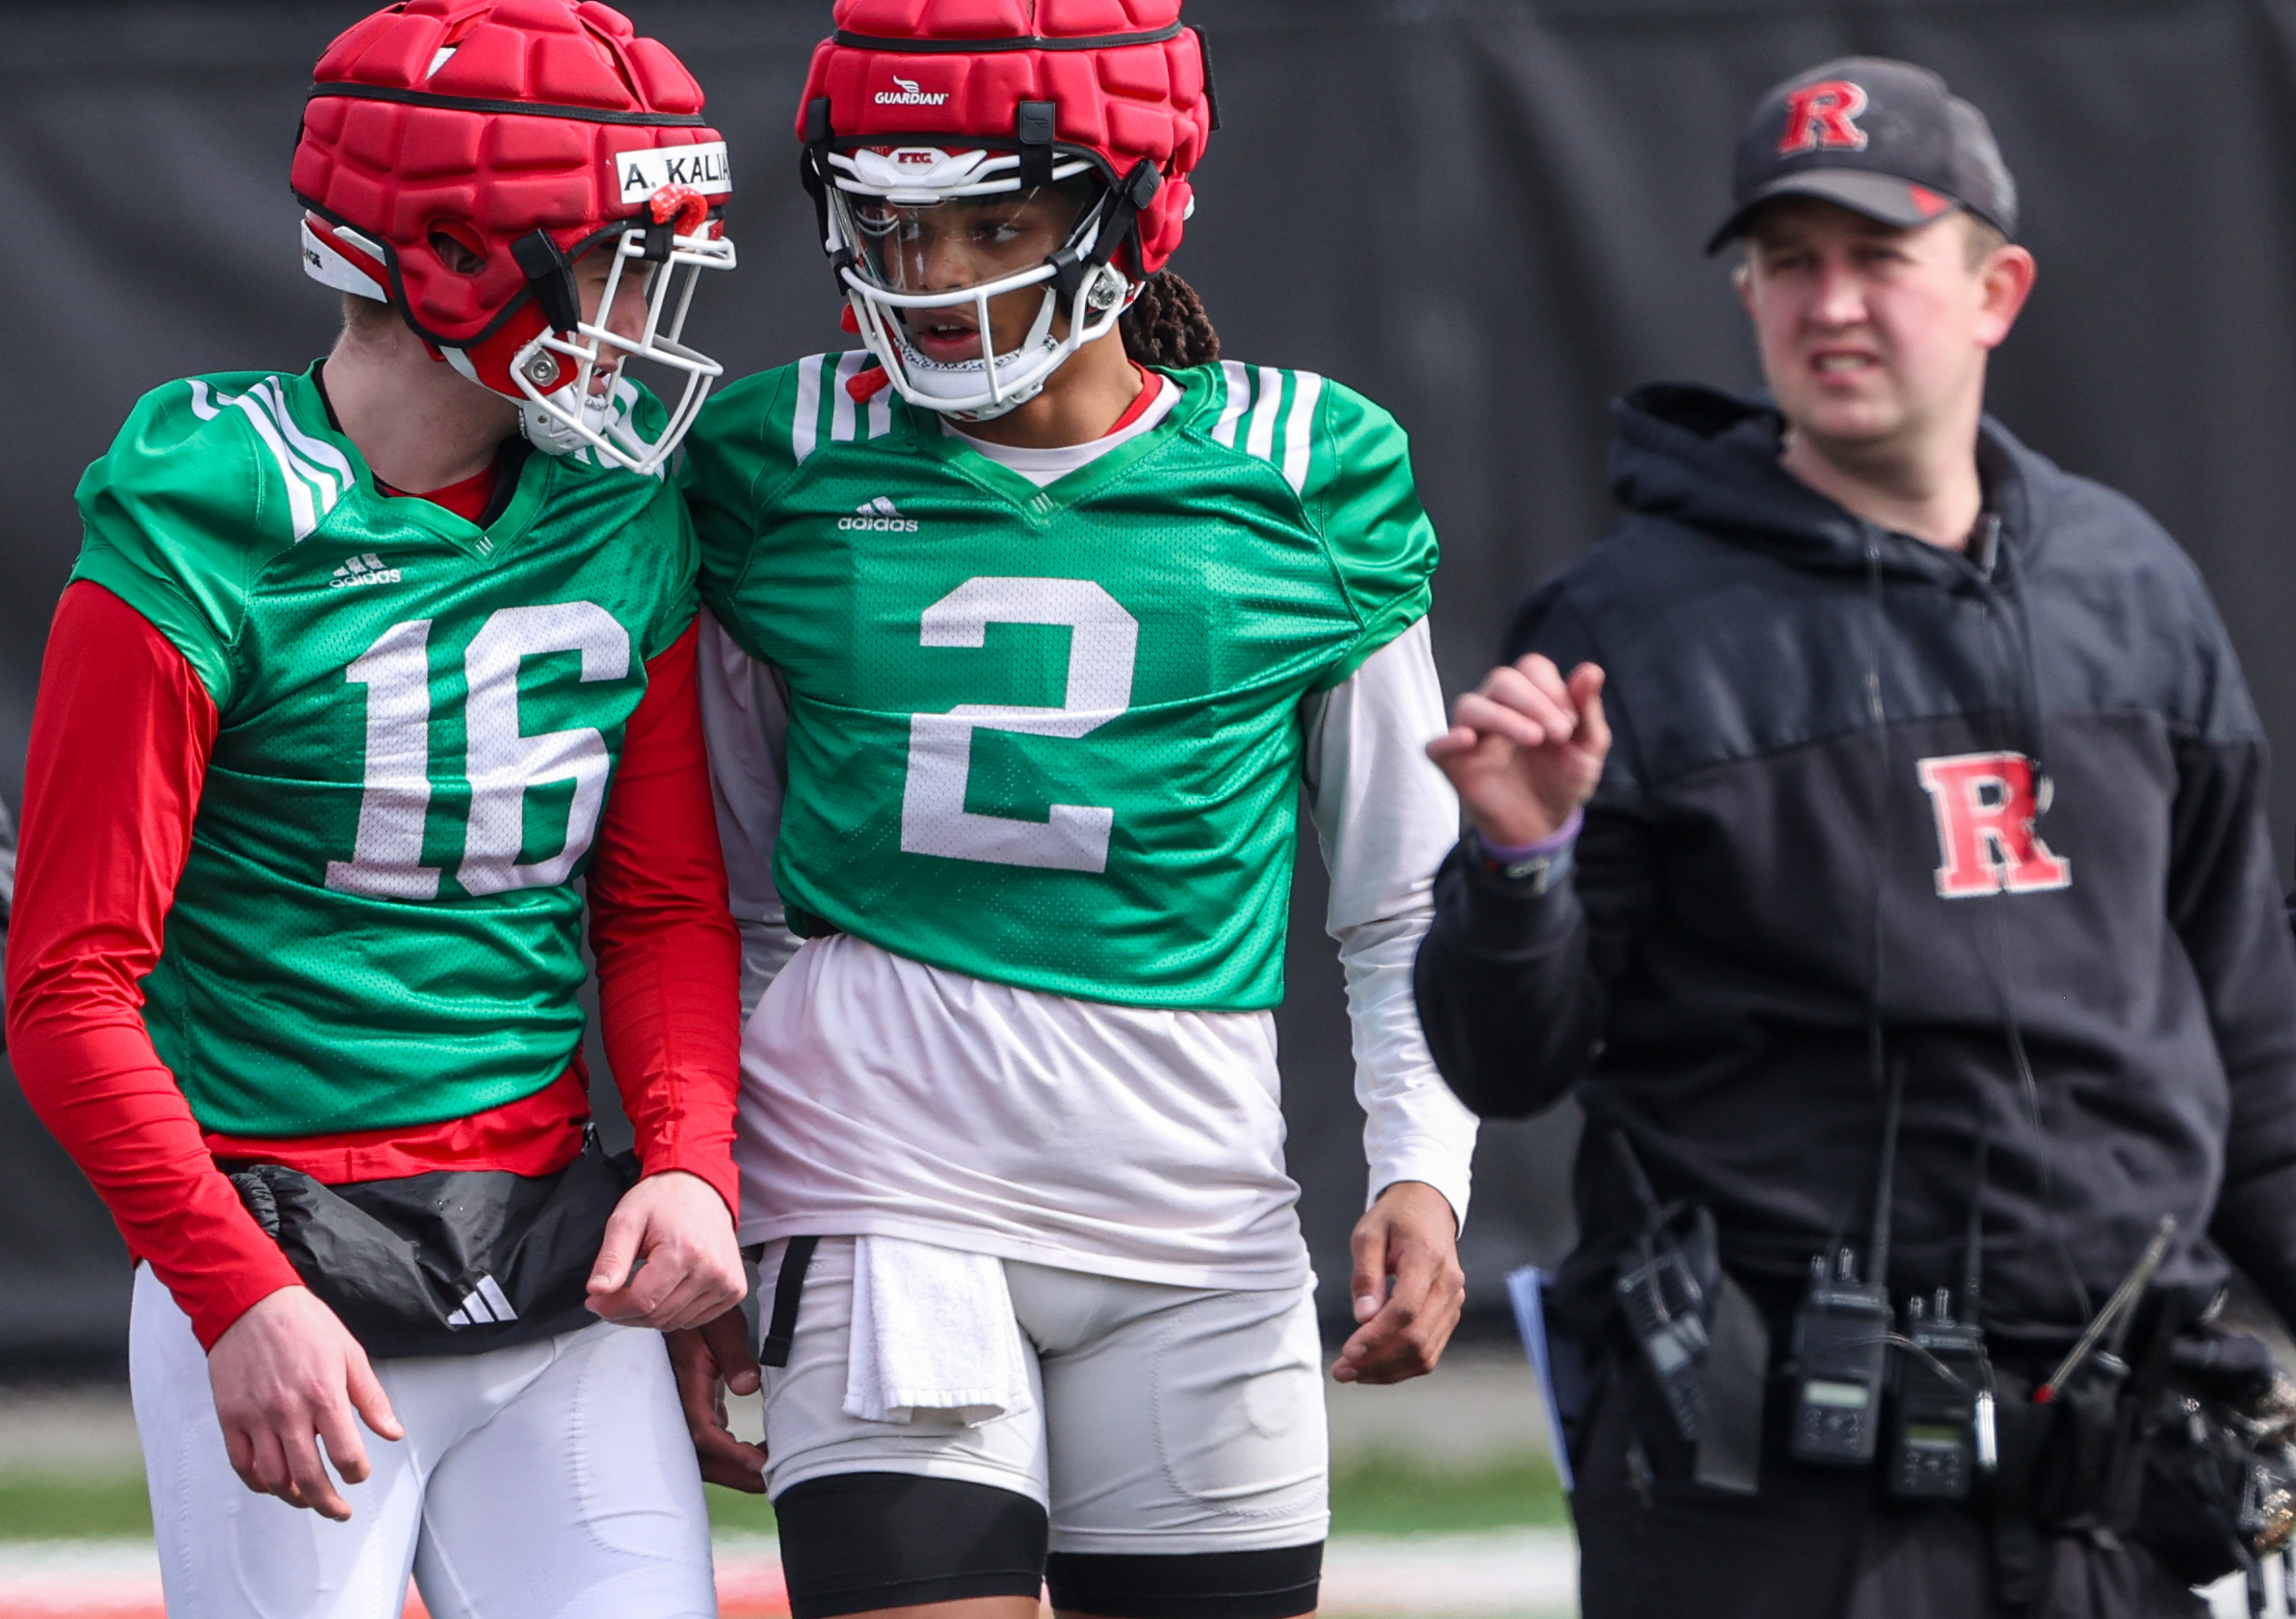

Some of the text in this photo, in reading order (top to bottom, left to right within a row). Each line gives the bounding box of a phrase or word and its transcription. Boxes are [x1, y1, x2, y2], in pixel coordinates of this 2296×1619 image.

[874, 92, 945, 105] GUARDIAN
[1779, 80, 1868, 157] R
[624, 163, 657, 191] A.
[836, 515, 918, 532] adidas
[330, 568, 402, 588] adidas
[325, 600, 631, 900] 16
[901, 576, 1140, 873] 2
[1916, 750, 2072, 899] R
